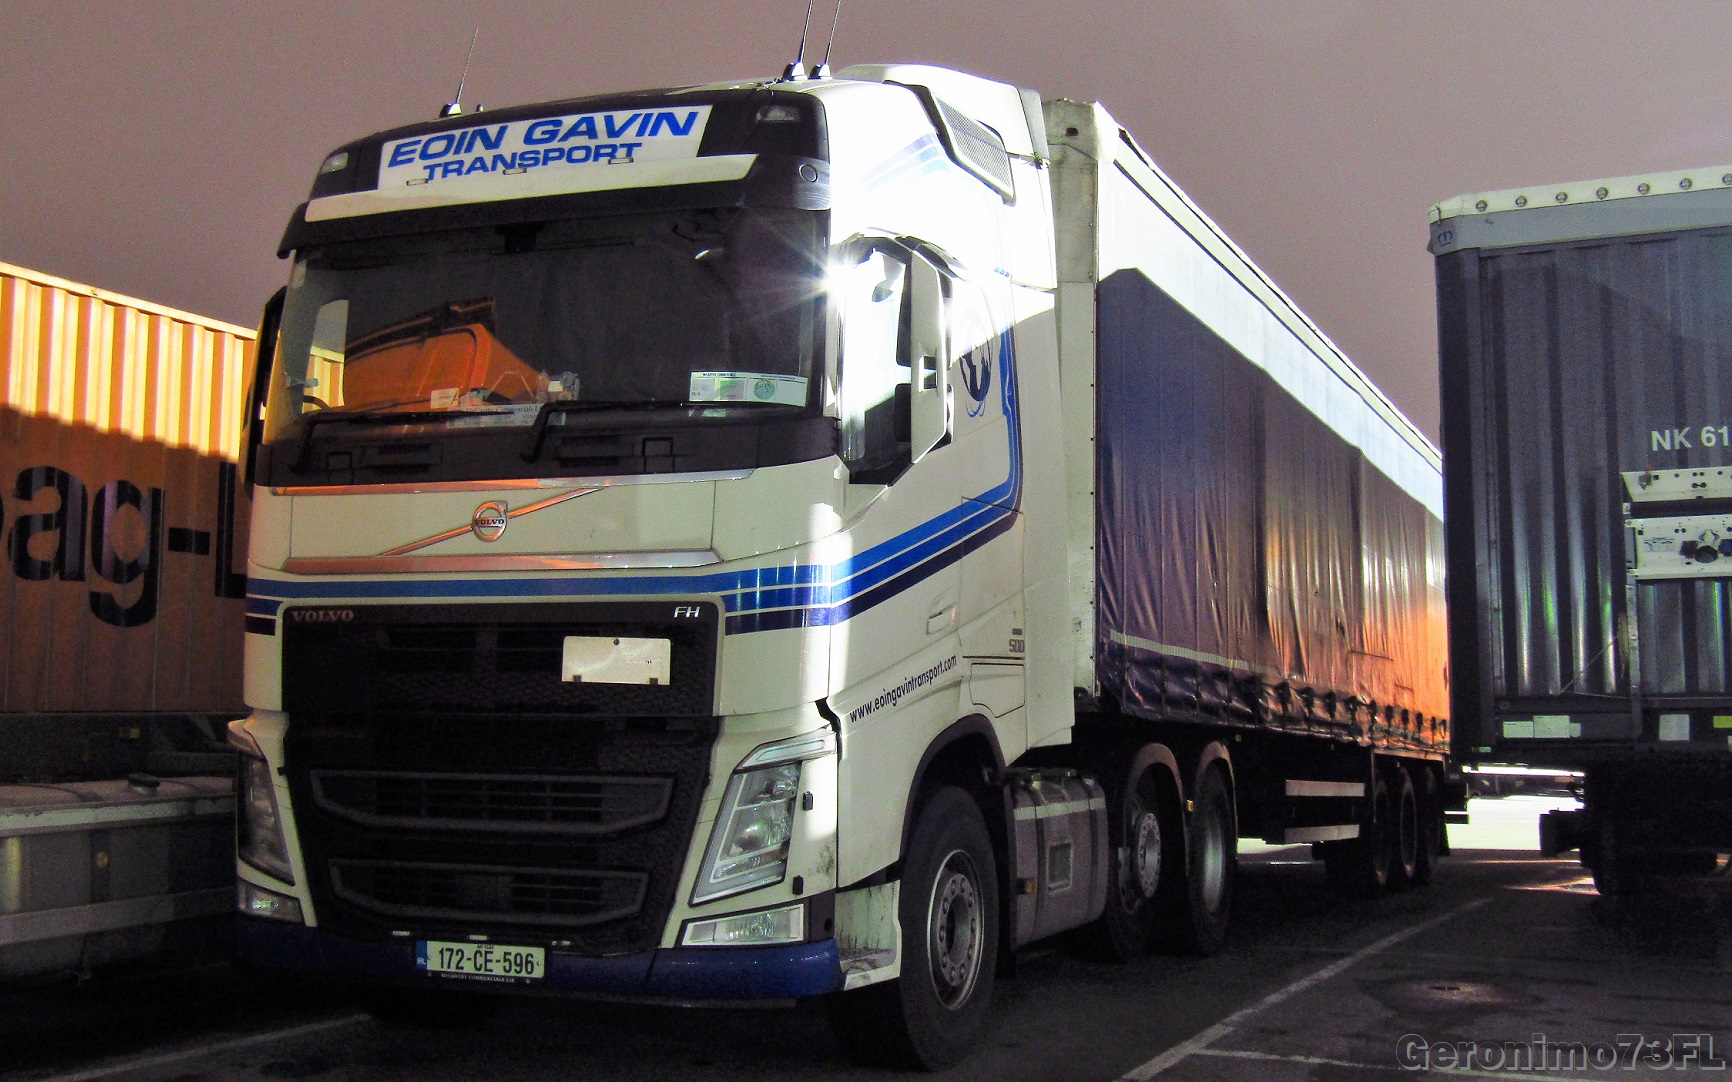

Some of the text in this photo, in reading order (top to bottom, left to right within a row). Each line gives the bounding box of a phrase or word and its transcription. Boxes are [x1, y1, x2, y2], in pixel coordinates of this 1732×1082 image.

[388, 111, 699, 168] EOIN GAVIN
[423, 142, 642, 182] TRANSPORT
[1651, 425, 1729, 451] NK 61
[474, 518, 505, 526] VOLVO
[0, 461, 247, 628] ag-L
[292, 609, 354, 622] VOLVO
[673, 606, 700, 618] FH
[1009, 638, 1025, 653] 500
[850, 654, 957, 723] www.eoingavintransport.com
[439, 946, 534, 975] 172-CE-596
